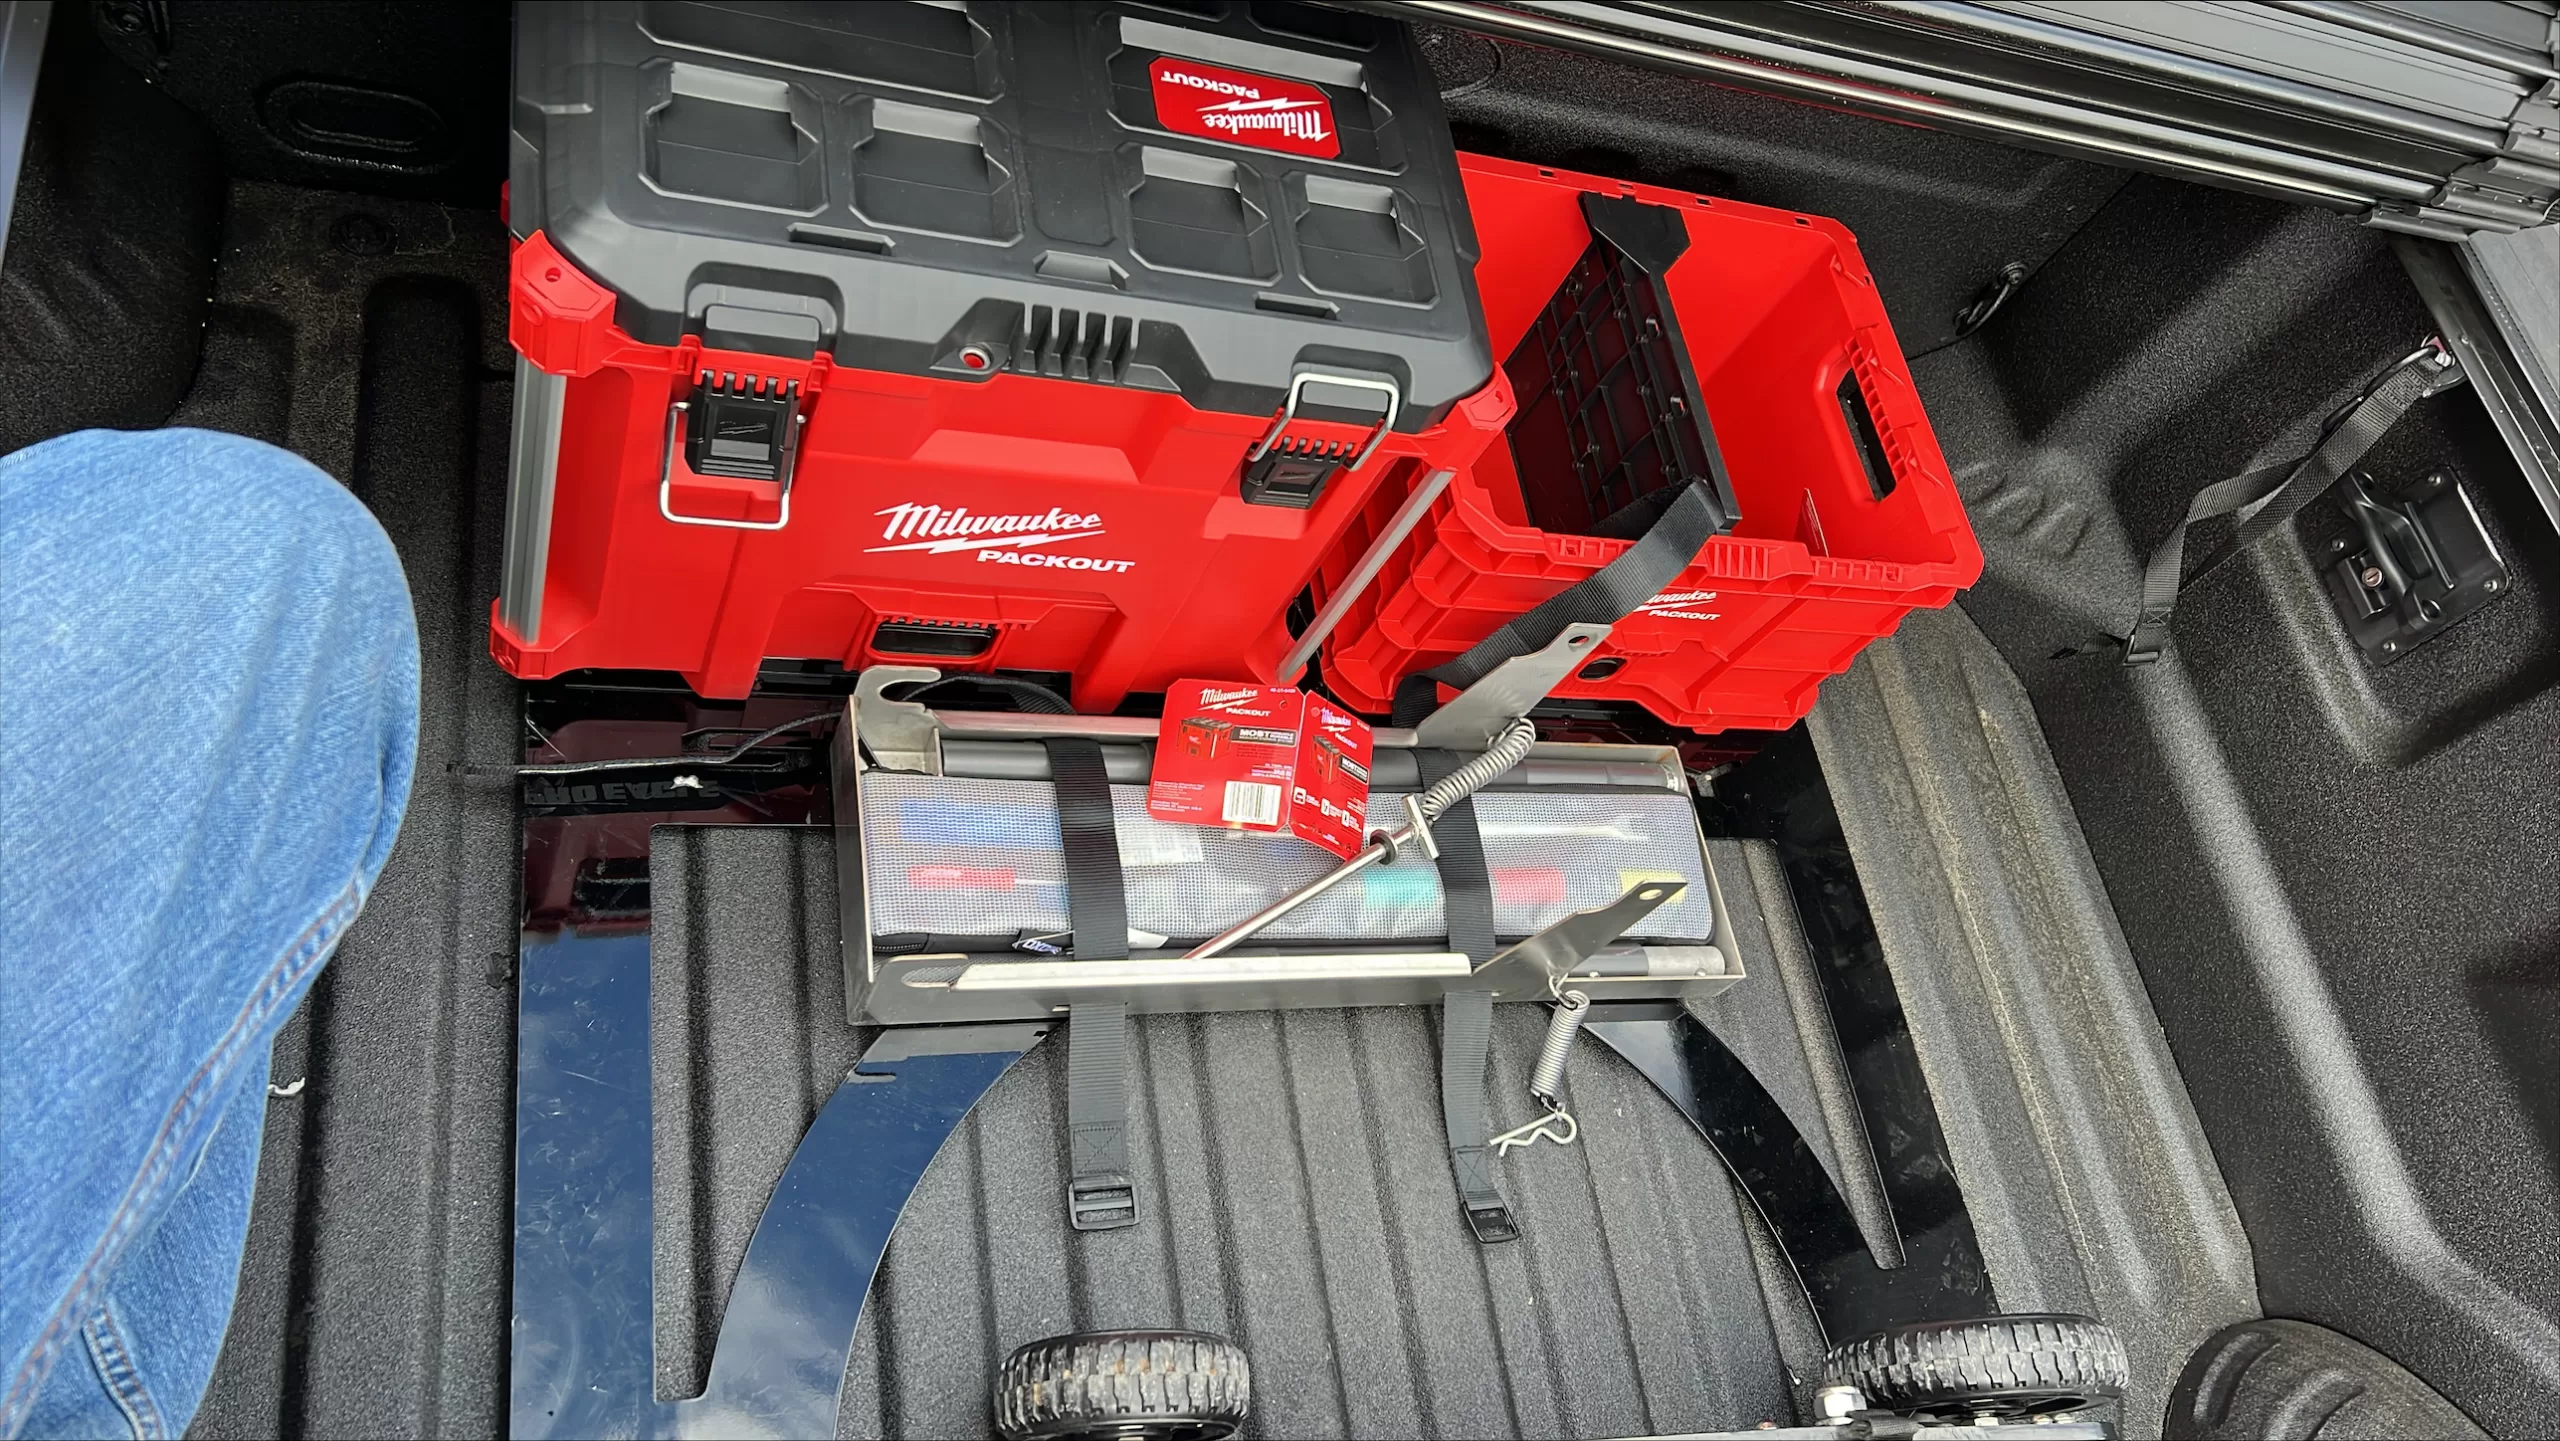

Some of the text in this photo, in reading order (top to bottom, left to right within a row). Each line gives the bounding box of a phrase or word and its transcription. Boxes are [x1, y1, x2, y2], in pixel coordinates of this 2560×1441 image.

[1161, 71, 1260, 100] PACKOUT
[1202, 109, 1331, 142] Milwaukee
[874, 501, 1103, 541] Milwaukee
[976, 549, 1136, 574] PACKOUT
[1648, 609, 1721, 621] PACKOUT
[1200, 688, 1258, 705] Milwaukee
[1226, 707, 1271, 717] PACKOUT
